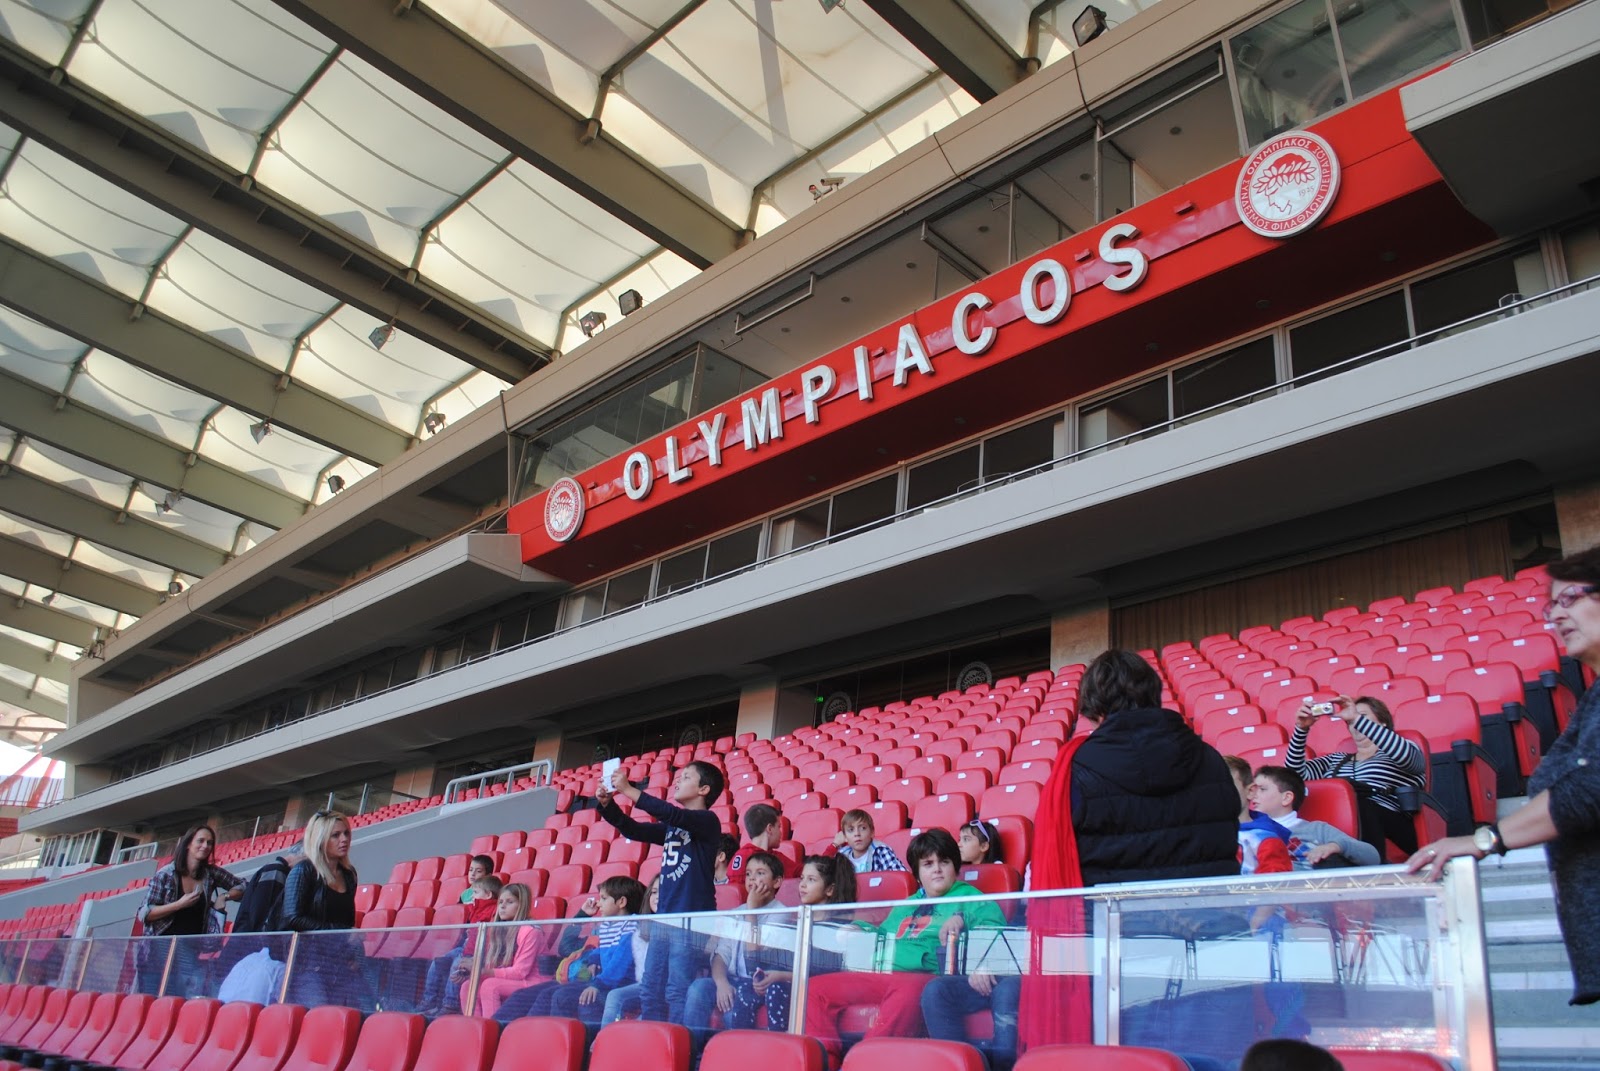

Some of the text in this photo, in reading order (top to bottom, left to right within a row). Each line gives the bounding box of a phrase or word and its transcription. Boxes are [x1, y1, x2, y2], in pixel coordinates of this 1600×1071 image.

[1247, 138, 1312, 175] ΟΛΥΜΠΙΑΚΟΣ
[1241, 145, 1331, 231] ΣΥΝΔΕΣΜΟΣ ΦΙΛΑΘΛΩΝ ΠΕΙΡΑΙΩΣ
[1298, 186, 1315, 197] 1925
[622, 222, 1149, 501] OLYMPIACOS
